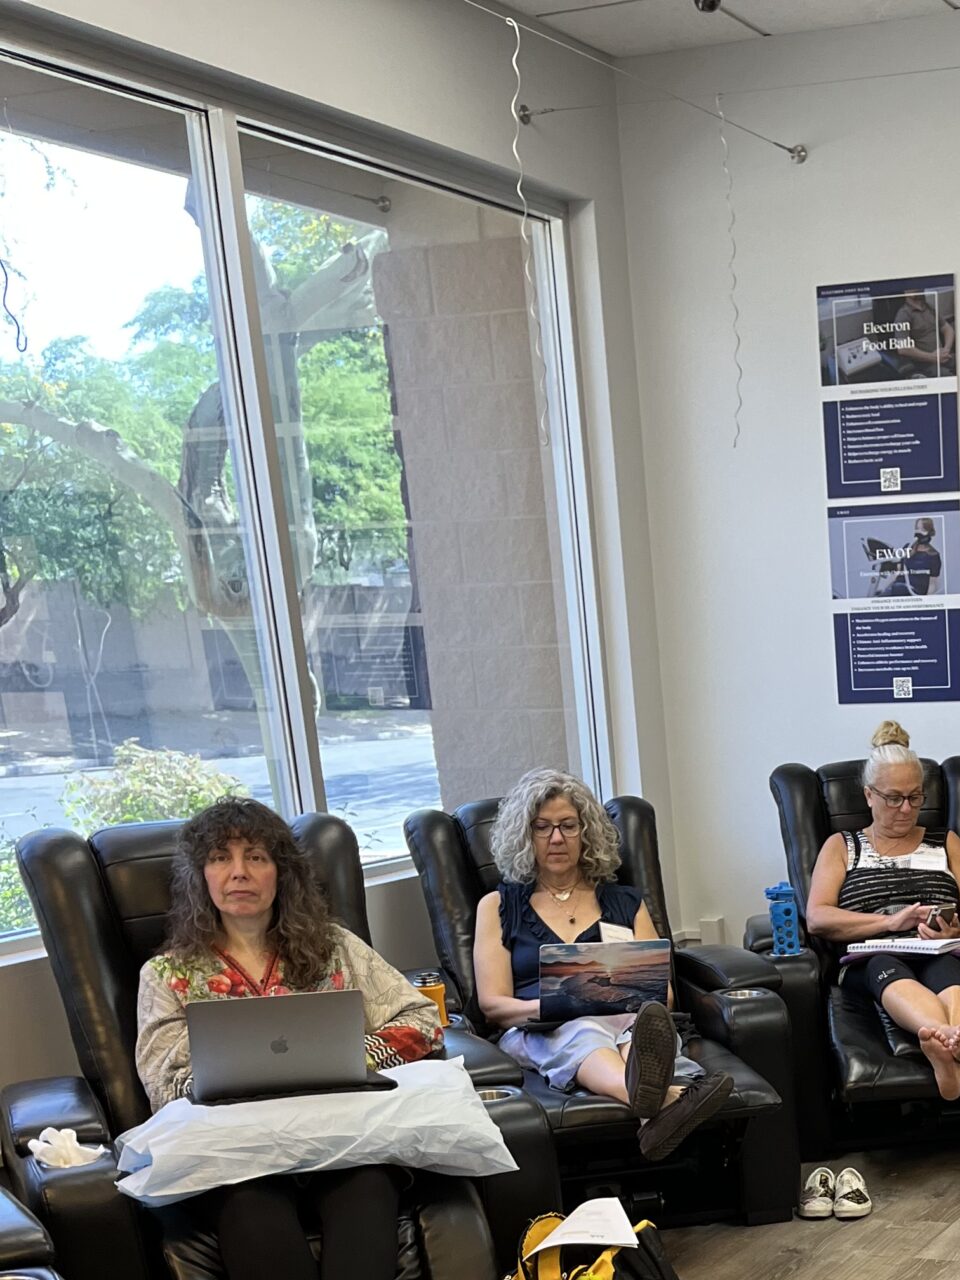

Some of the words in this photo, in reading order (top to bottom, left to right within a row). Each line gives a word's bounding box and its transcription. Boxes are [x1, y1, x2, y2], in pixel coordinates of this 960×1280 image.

[863, 321, 911, 335] Electron
[862, 338, 887, 352] Foot
[889, 336, 915, 350] Bath
[876, 547, 913, 560] EWOT
